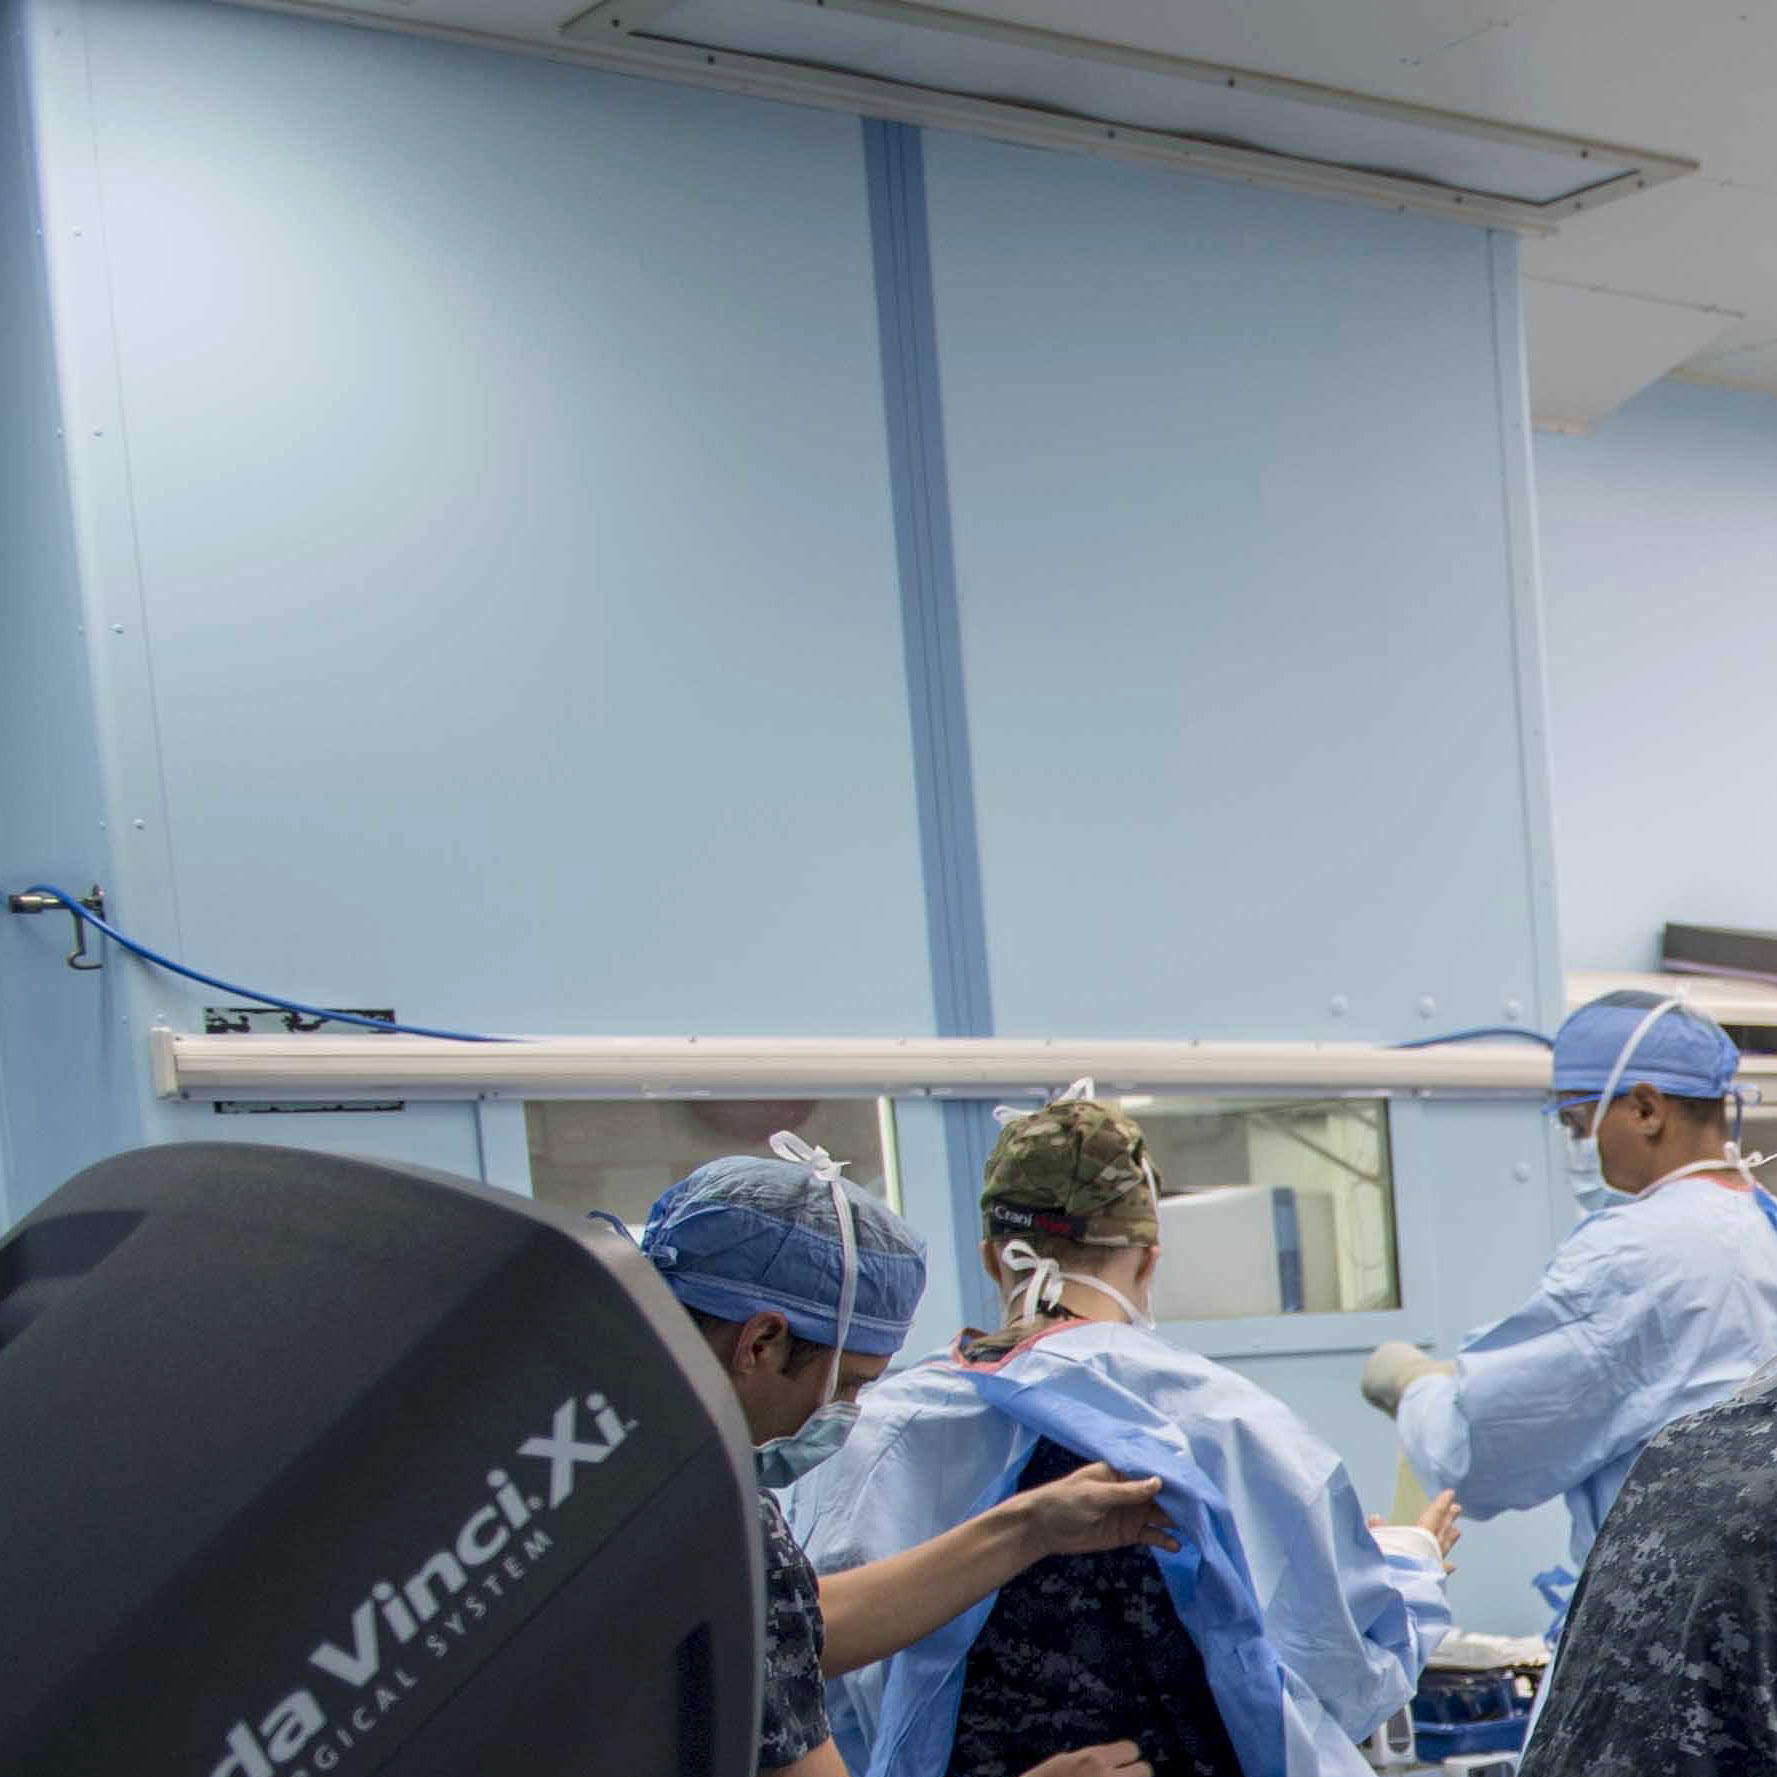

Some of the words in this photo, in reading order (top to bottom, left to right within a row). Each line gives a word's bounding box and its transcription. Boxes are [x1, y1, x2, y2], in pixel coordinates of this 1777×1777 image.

[308, 1468, 532, 1688] Vinci
[515, 1393, 628, 1510] Xi
[426, 1529, 555, 1659] SYSTEM
